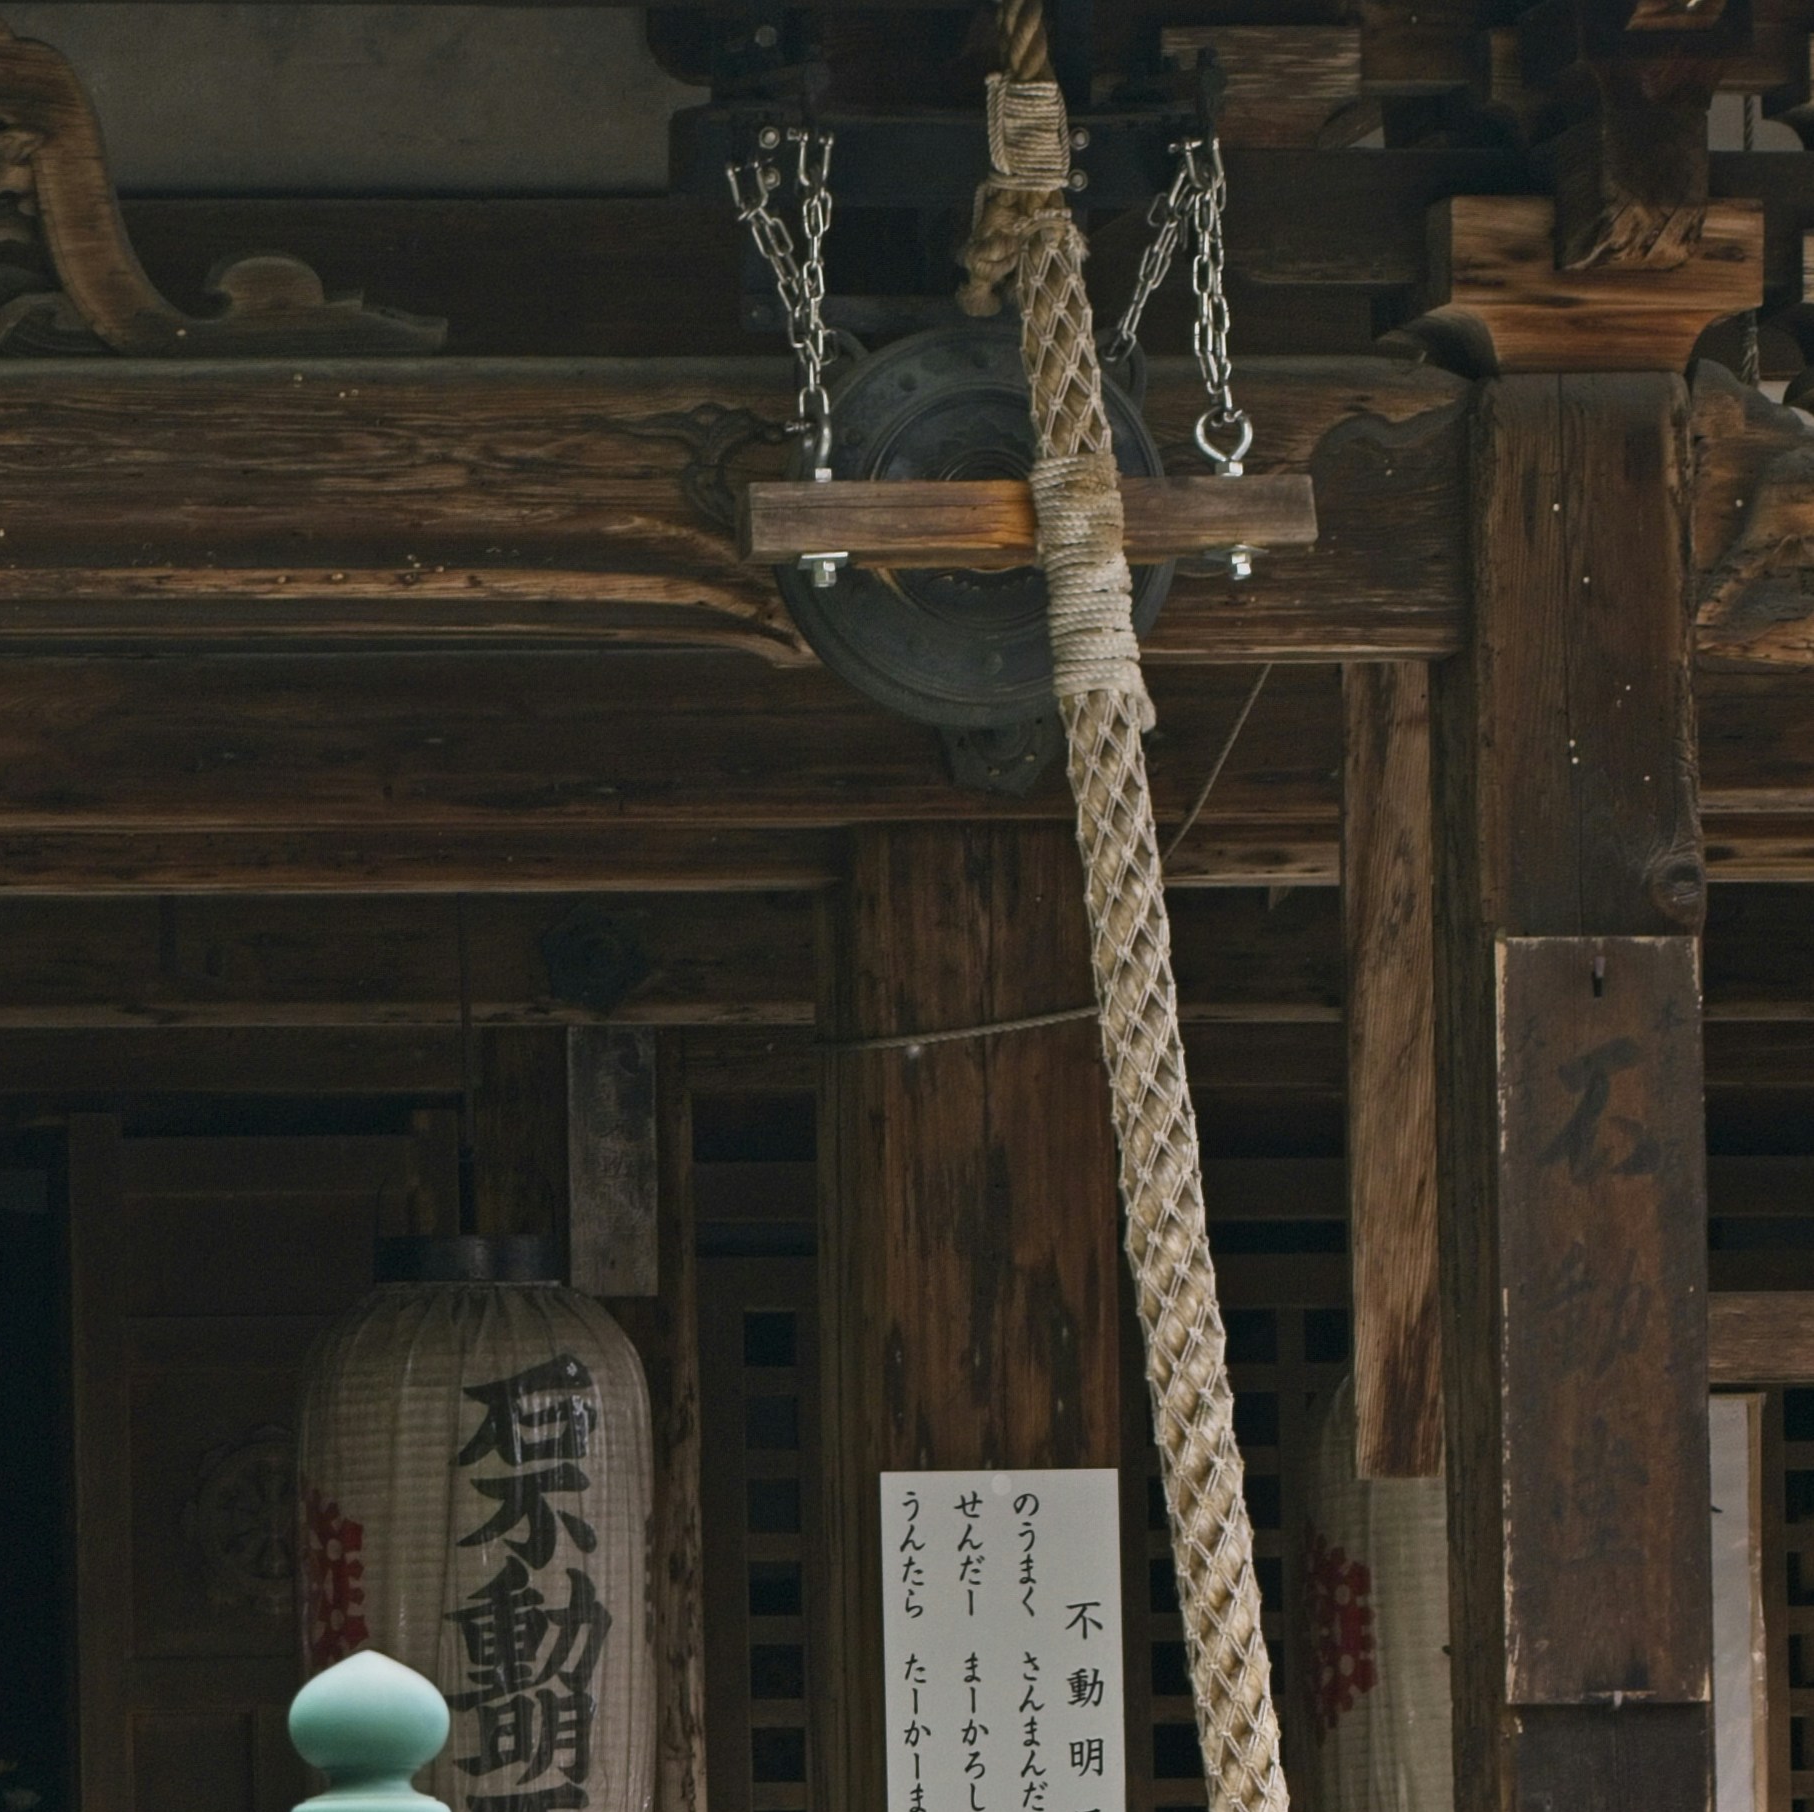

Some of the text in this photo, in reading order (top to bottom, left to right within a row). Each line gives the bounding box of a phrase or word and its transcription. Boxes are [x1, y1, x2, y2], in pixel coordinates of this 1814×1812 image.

[899, 1491, 926, 1619] うんたら
[953, 1490, 985, 1617] せんだー
[1012, 1493, 1040, 1617] のうまく
